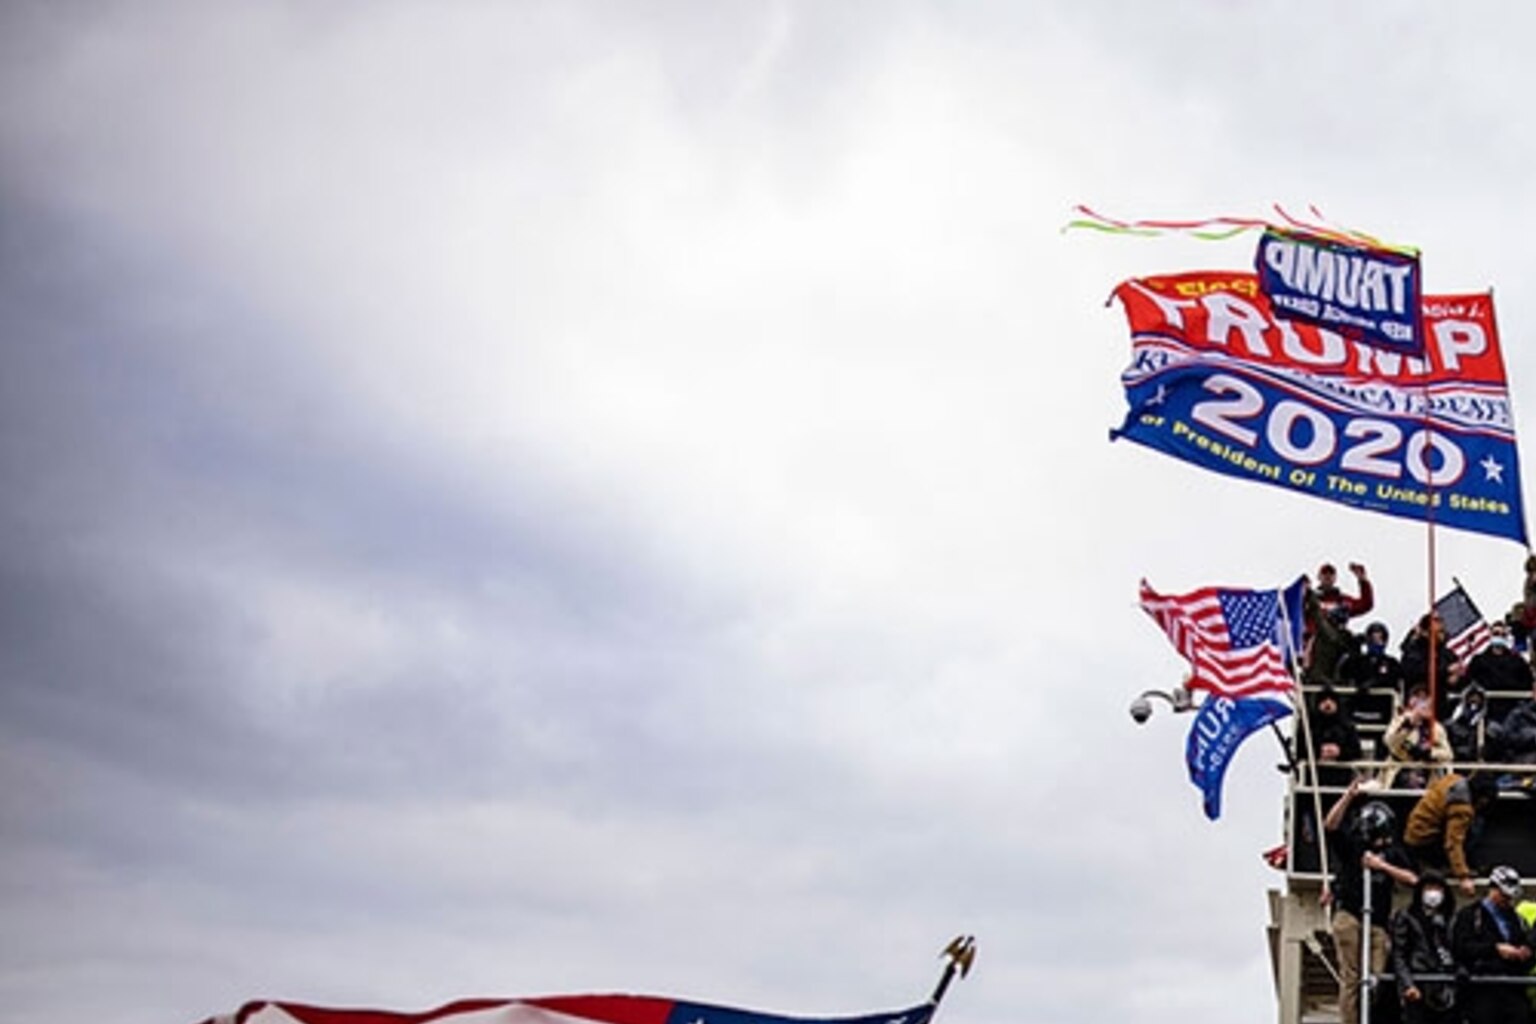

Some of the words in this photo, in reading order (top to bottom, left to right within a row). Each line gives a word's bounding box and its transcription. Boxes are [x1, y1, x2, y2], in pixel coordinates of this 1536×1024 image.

[1172, 420, 1282, 480] President
[1289, 469, 1316, 487] Of
[1327, 475, 1368, 495] The
[1376, 484, 1442, 508] United
[1450, 494, 1511, 515] States
[1192, 374, 1465, 486] 2020
